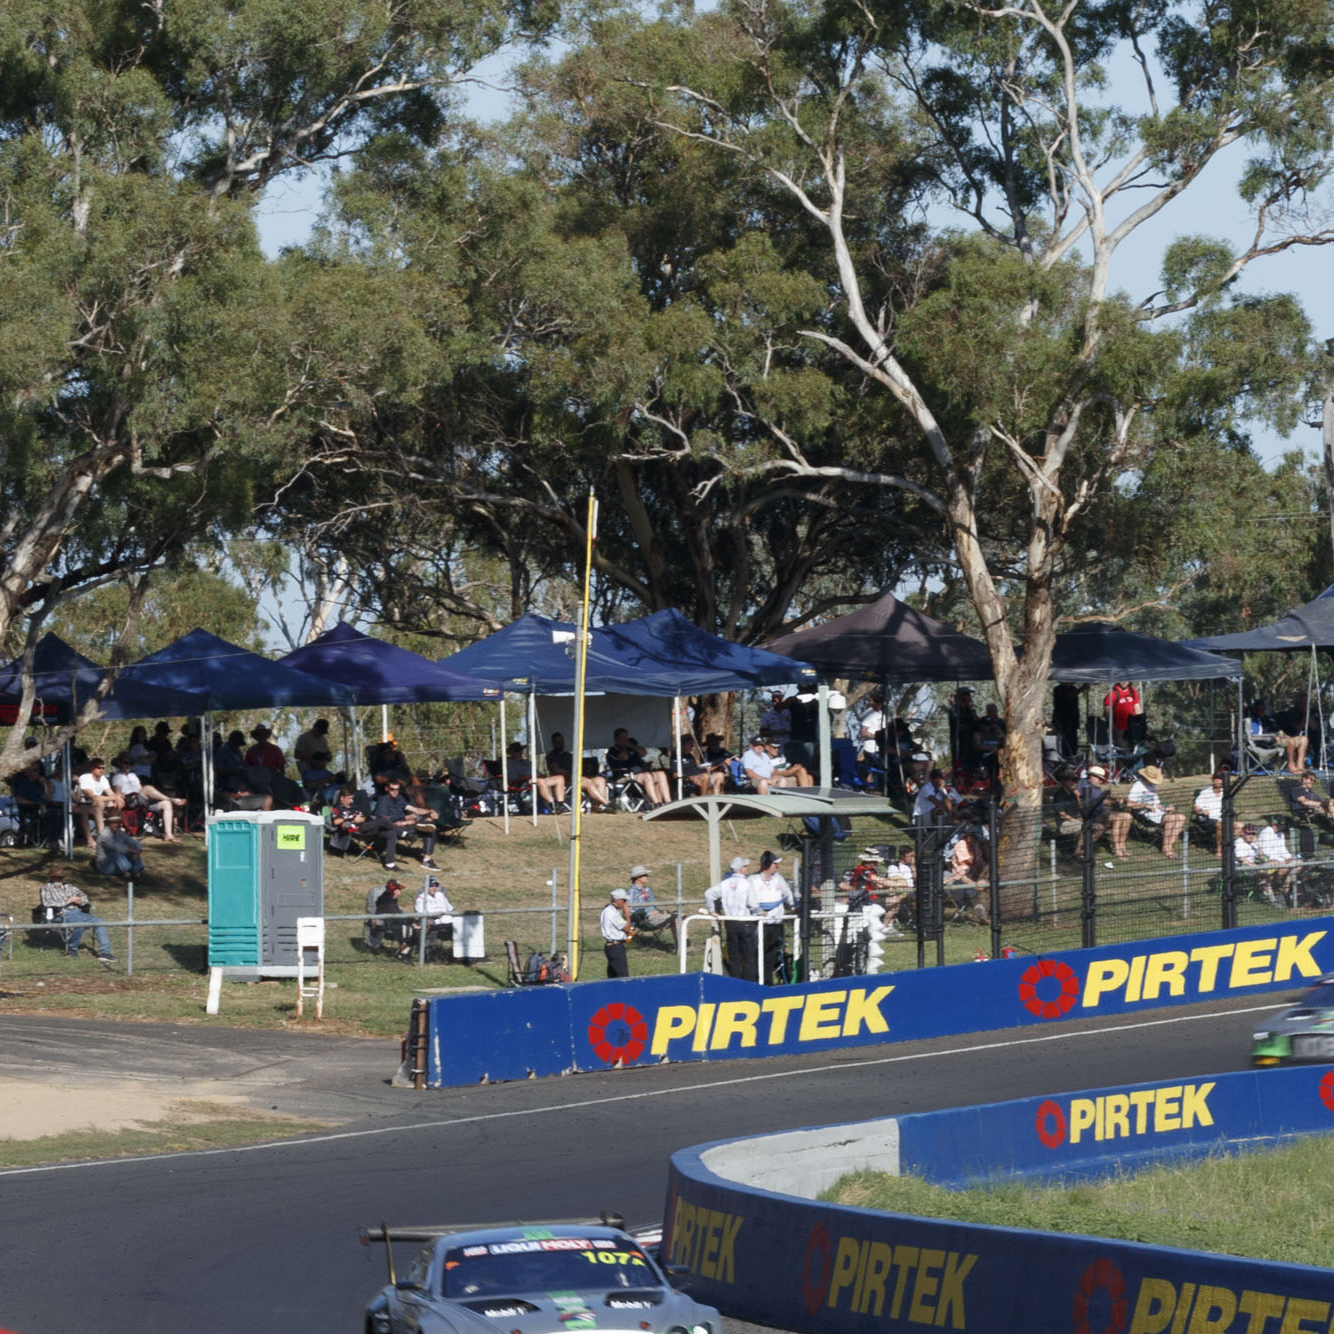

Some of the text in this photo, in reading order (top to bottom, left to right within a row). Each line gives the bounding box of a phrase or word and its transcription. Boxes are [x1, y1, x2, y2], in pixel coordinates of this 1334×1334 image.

[1082, 930, 1328, 1008] PIRTEK
[651, 985, 895, 1055] PIRTEK
[1069, 1082, 1215, 1144] PIRTEK
[828, 1236, 979, 1330] PIRTEK
